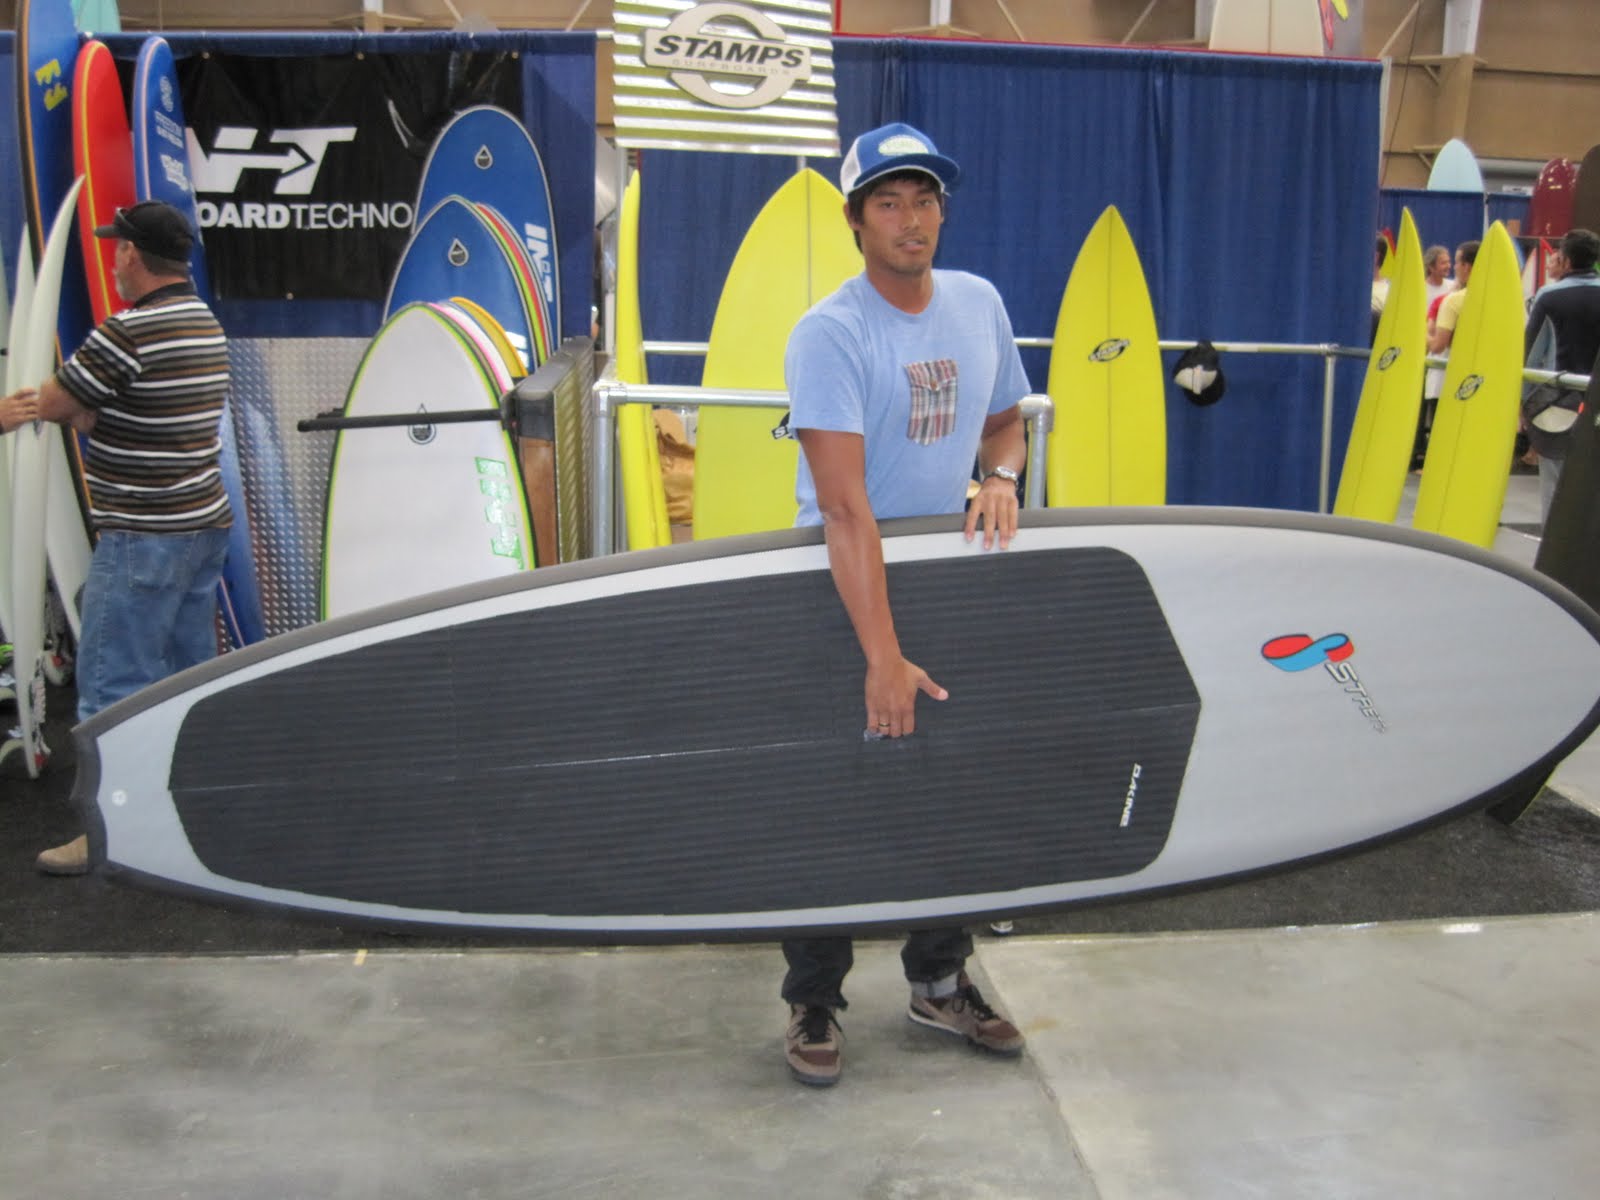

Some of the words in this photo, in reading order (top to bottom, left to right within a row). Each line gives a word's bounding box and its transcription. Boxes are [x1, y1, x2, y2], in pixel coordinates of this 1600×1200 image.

[654, 35, 804, 68] STAMPS
[672, 59, 791, 75] SURFBOARDS
[196, 202, 413, 229] OARDTECHNO
[1120, 763, 1142, 828] DAKINE
